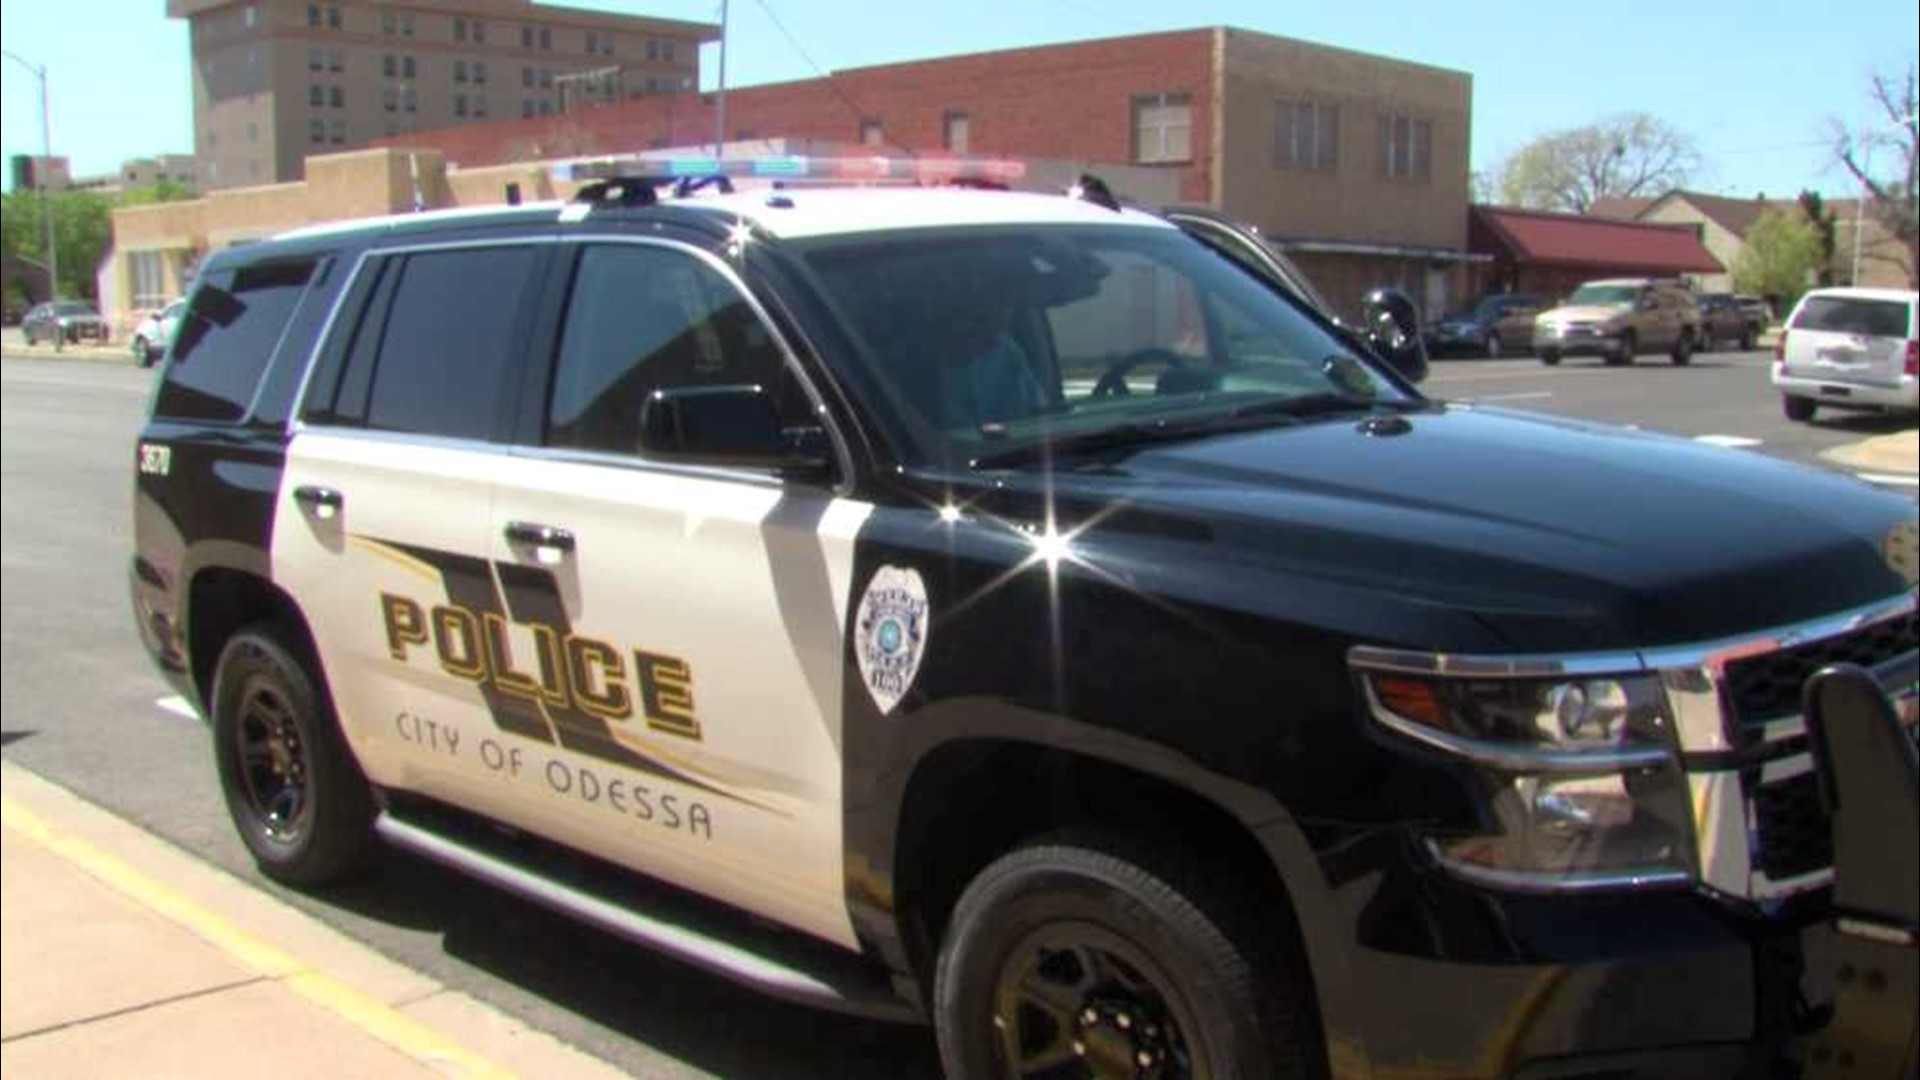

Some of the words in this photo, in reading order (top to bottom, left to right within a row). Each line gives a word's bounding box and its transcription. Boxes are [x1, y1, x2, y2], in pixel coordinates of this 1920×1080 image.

[380, 591, 704, 742] POLICE
[396, 711, 460, 753] CITY
[480, 738, 524, 774] OF
[546, 759, 713, 840] ODESSA
